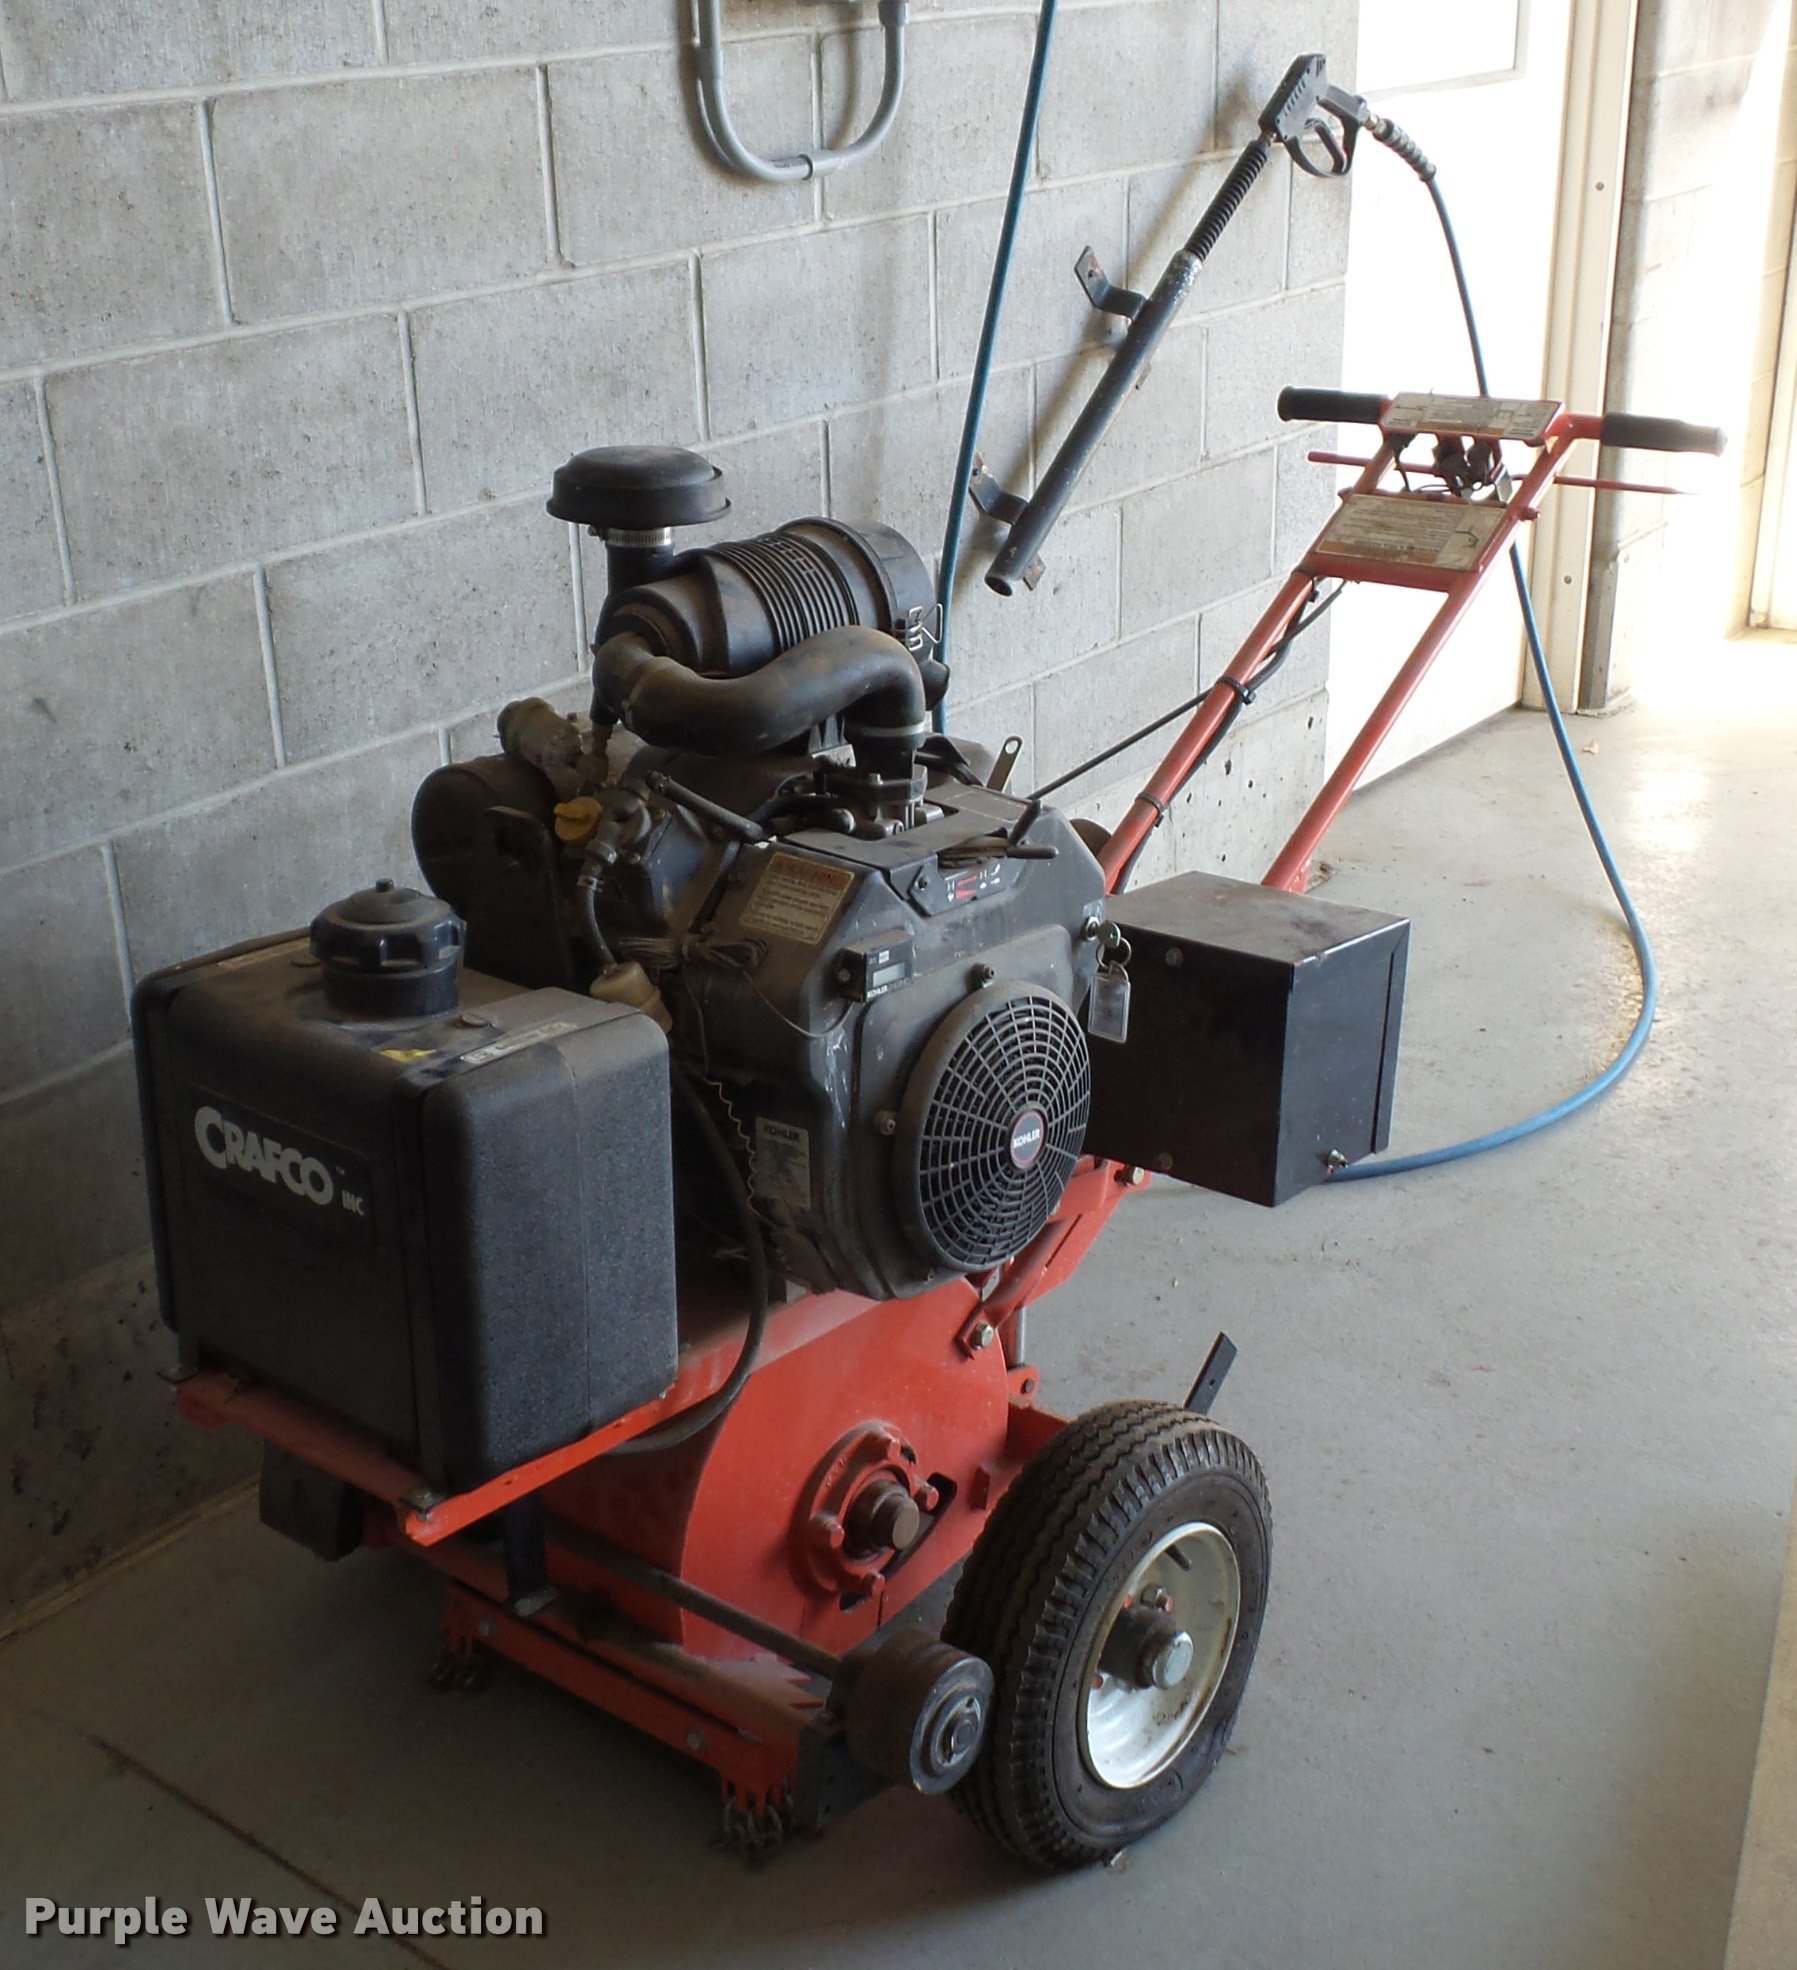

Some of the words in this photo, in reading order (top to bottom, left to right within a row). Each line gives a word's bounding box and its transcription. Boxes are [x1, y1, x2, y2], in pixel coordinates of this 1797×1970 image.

[1013, 1128, 1041, 1149] KOHLER
[194, 1106, 334, 1206] CRAFCO
[341, 1189, 365, 1217] INC
